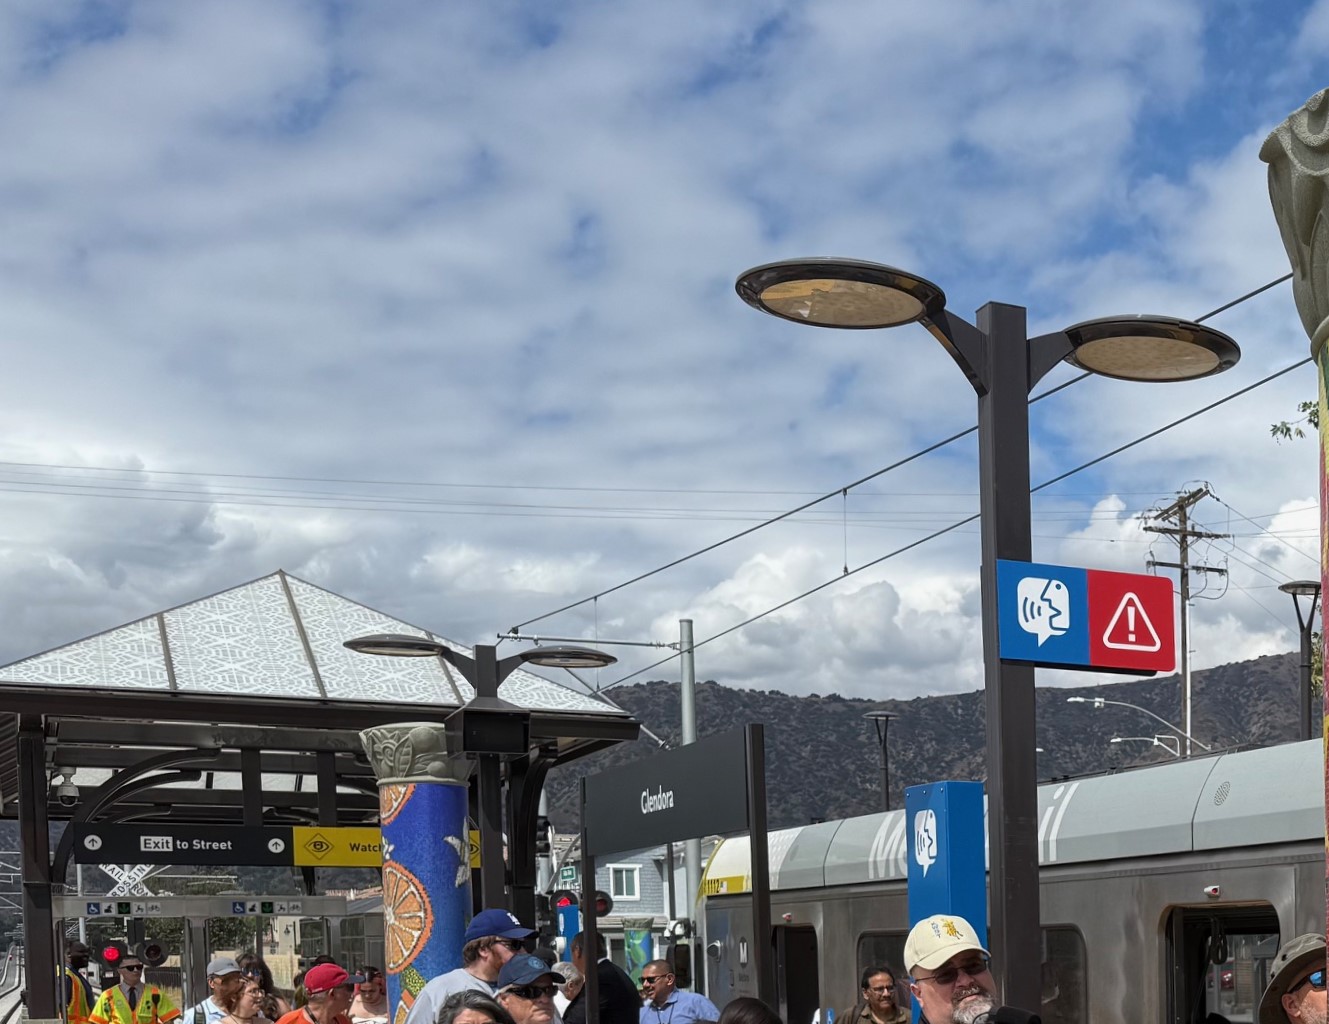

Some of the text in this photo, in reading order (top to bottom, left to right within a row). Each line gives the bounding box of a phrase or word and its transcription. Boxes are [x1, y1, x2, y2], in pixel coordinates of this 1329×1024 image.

[641, 785, 674, 814] Glendora
[143, 838, 233, 850] Exit to Street
